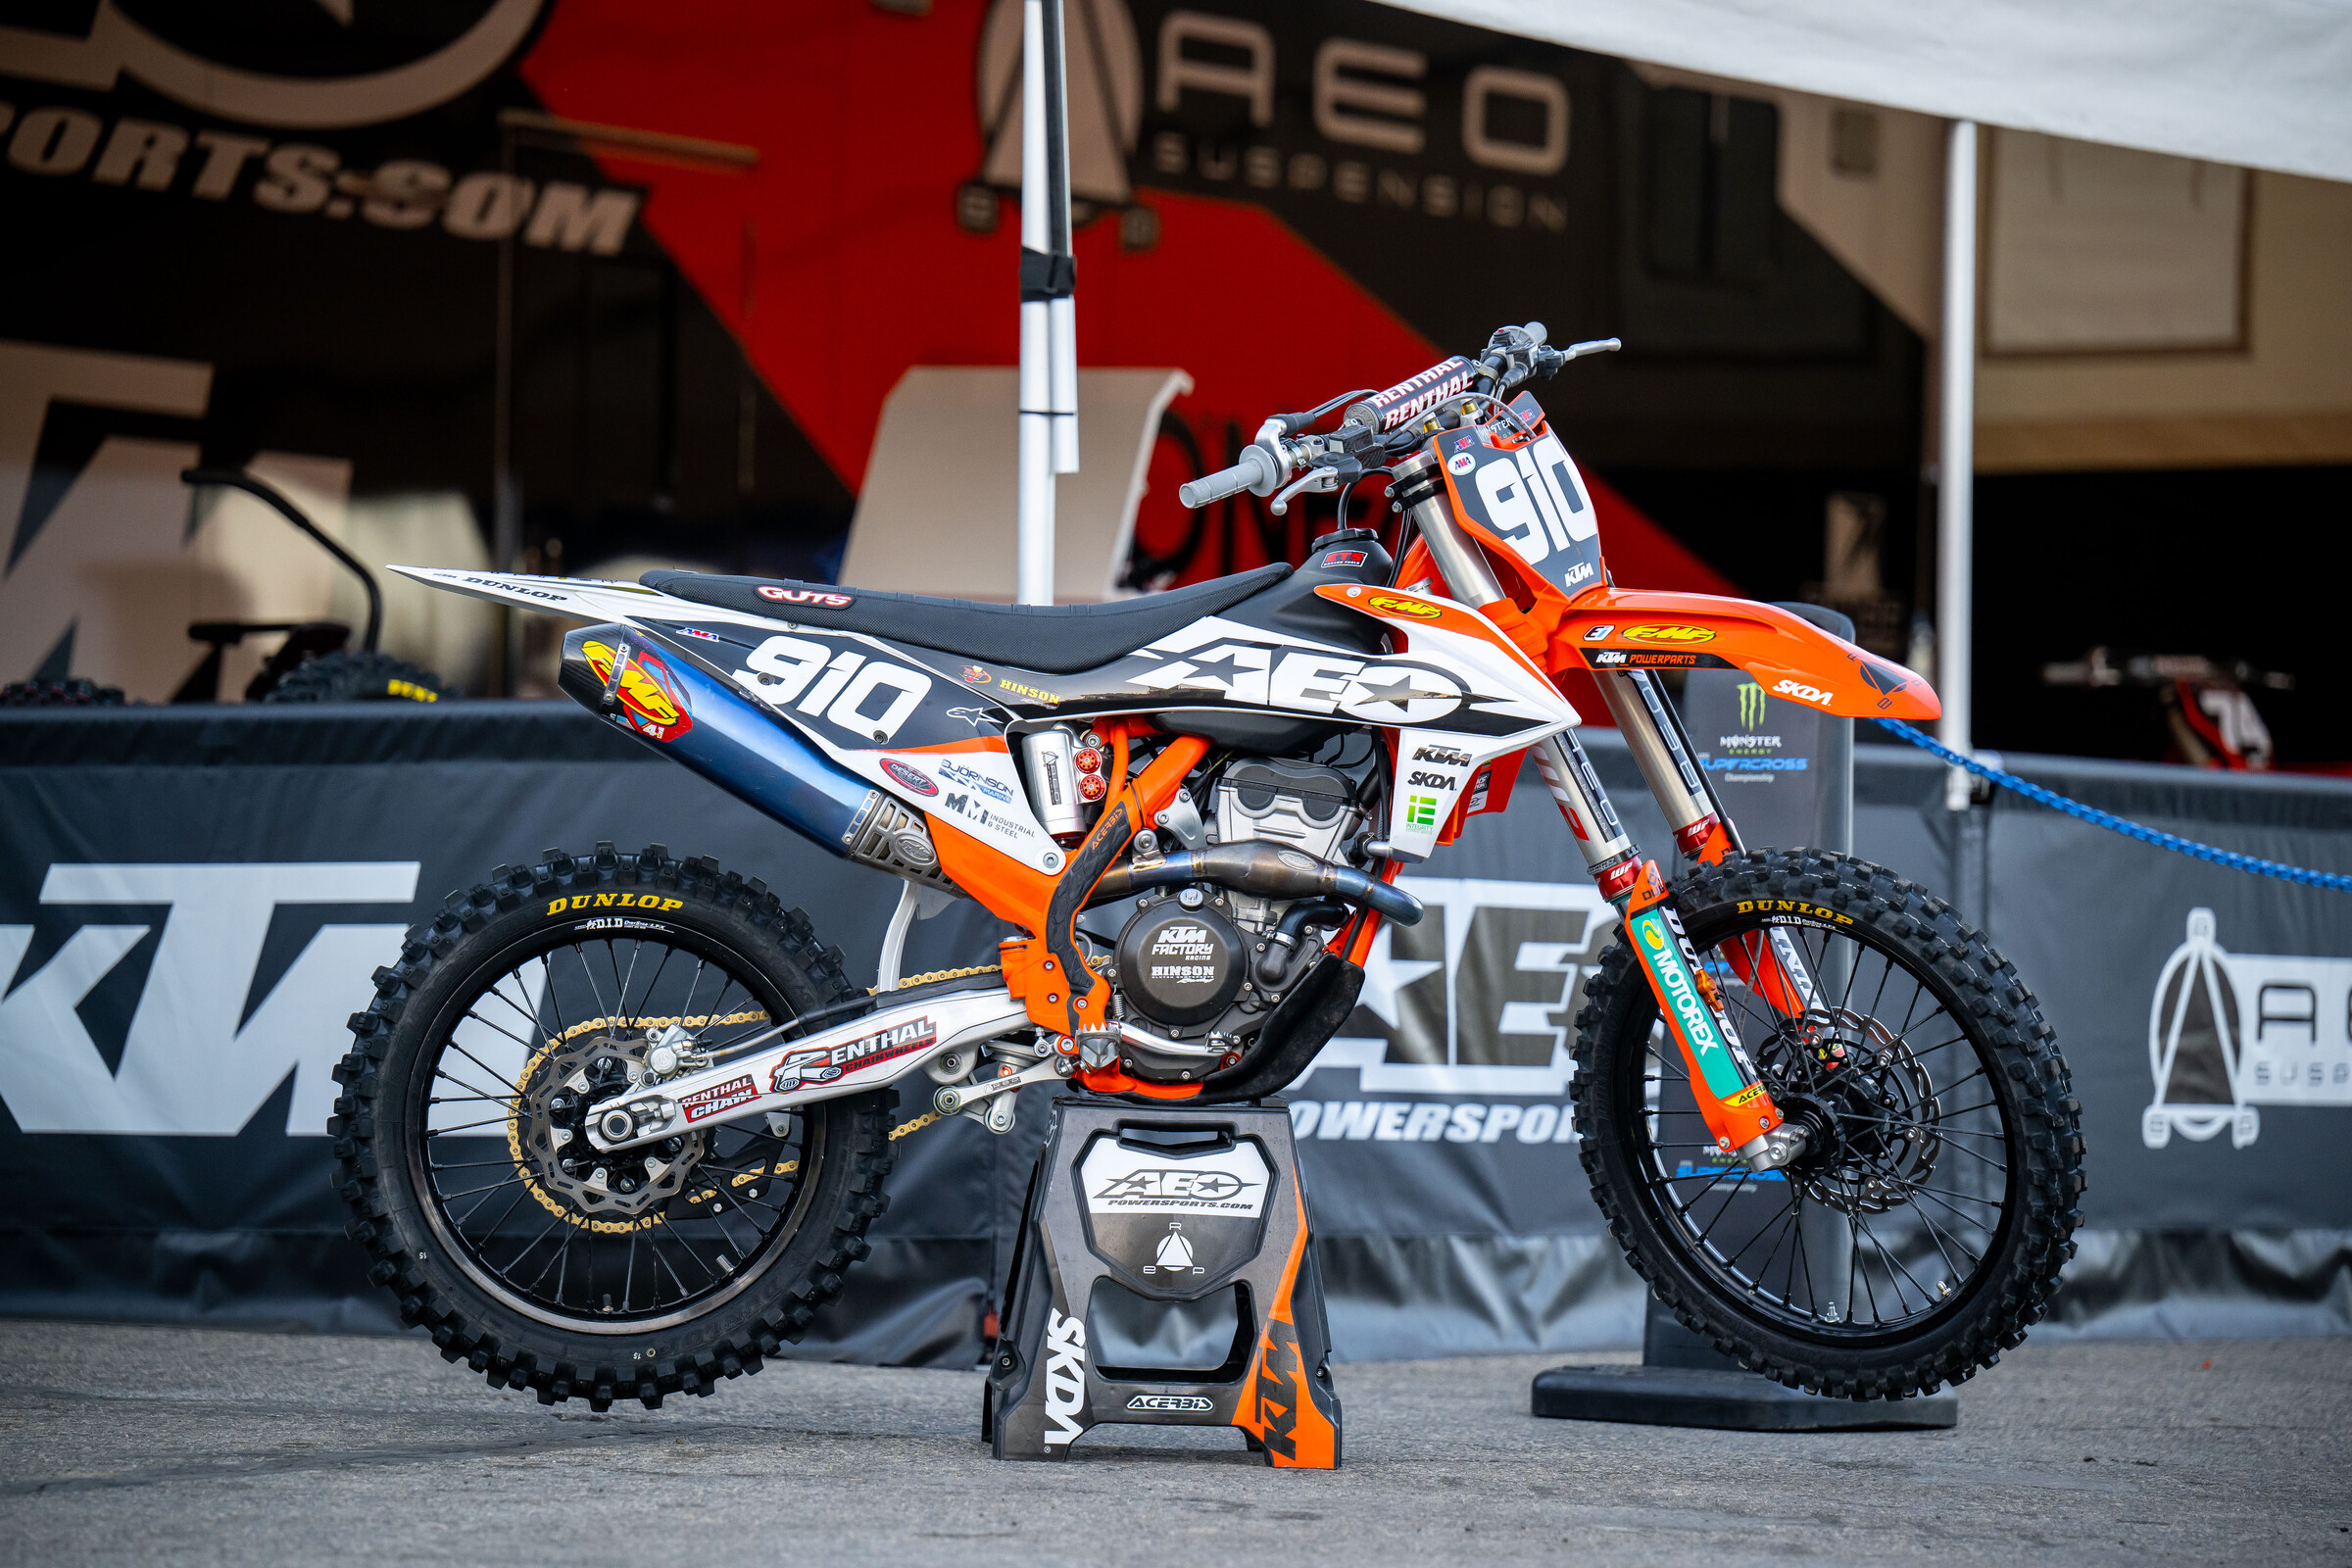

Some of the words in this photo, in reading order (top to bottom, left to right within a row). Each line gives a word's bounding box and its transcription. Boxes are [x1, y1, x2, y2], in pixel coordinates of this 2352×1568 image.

[1156, 14, 1568, 174] AEO
[1152, 133, 1567, 232] SUSPENSION
[1373, 360, 1464, 409] RENTHAL
[1384, 370, 1474, 431] RENTHAL
[1454, 456, 1472, 470] AMA
[1475, 435, 1598, 565] 910
[1325, 552, 1365, 564] ETS
[1564, 562, 1593, 588] KTM
[463, 575, 568, 603] DUNLOP
[757, 586, 853, 608] GUTS
[1368, 596, 1443, 618] FMF
[679, 627, 719, 641] AMA
[1622, 624, 1717, 643] FMF
[1595, 651, 1628, 663] KTM
[1629, 654, 1697, 665] POWERPARTS
[731, 635, 933, 745] 910
[1000, 678, 1061, 705] HINSON
[1124, 642, 1464, 724] AEO
[1772, 679, 1834, 706] SKDA
[1720, 735, 1783, 748] MONSTER
[1412, 745, 1473, 767] KTM
[1407, 770, 1457, 791] SKDA
[982, 787, 1012, 804] MARINE
[990, 813, 1036, 838] INDUSTRIAL
[994, 823, 1018, 840] STEEL
[1405, 822, 1434, 832] INTEGRITY
[1610, 861, 1634, 880] WP
[546, 893, 684, 916] DUNLOP
[1736, 900, 1854, 925] DUNLOP
[1156, 926, 1208, 944] KTM
[1151, 943, 1214, 956] FACTORY
[1151, 965, 1215, 976] HINSON
[1653, 947, 1719, 1057] MOTOREX
[773, 1019, 934, 1093] RENTHAL
[845, 1037, 935, 1073] CHAINWHEELS
[681, 1076, 752, 1108] RENTHAL
[690, 1087, 754, 1119] CHAIN
[1092, 1168, 1245, 1201] AEO
[1107, 1199, 1253, 1210] POWERSPORTS.COM
[1044, 1306, 1086, 1446] SKDA
[1255, 1318, 1299, 1461] KTM
[1127, 1396, 1214, 1412] ACERBIS
